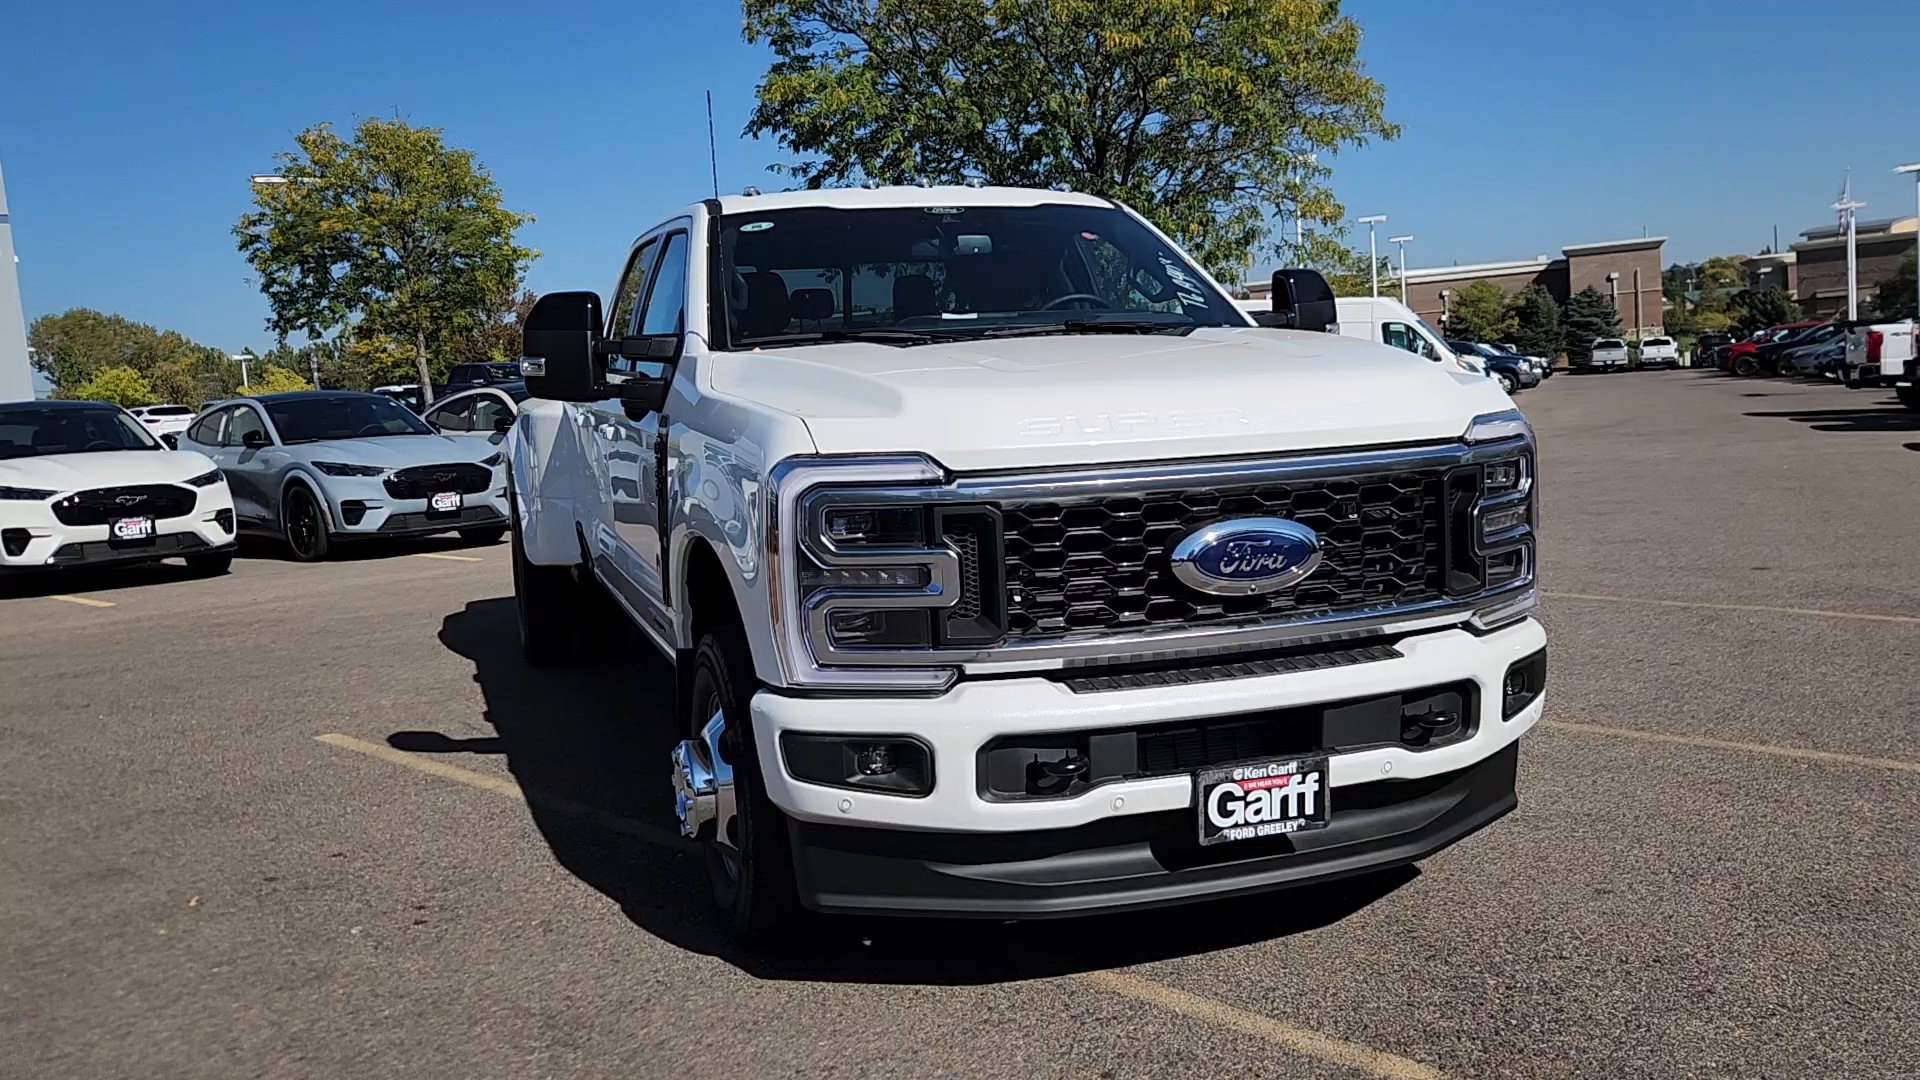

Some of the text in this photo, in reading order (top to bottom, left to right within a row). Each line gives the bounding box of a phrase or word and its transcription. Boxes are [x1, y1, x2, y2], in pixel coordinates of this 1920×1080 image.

[431, 493, 461, 509] Garff
[114, 519, 152, 537] Garff
[1219, 539, 1290, 574] Ford
[1243, 761, 1298, 780] Ken Garff
[1207, 772, 1319, 828] Garff
[1230, 821, 1299, 841] FORD GREELEY
